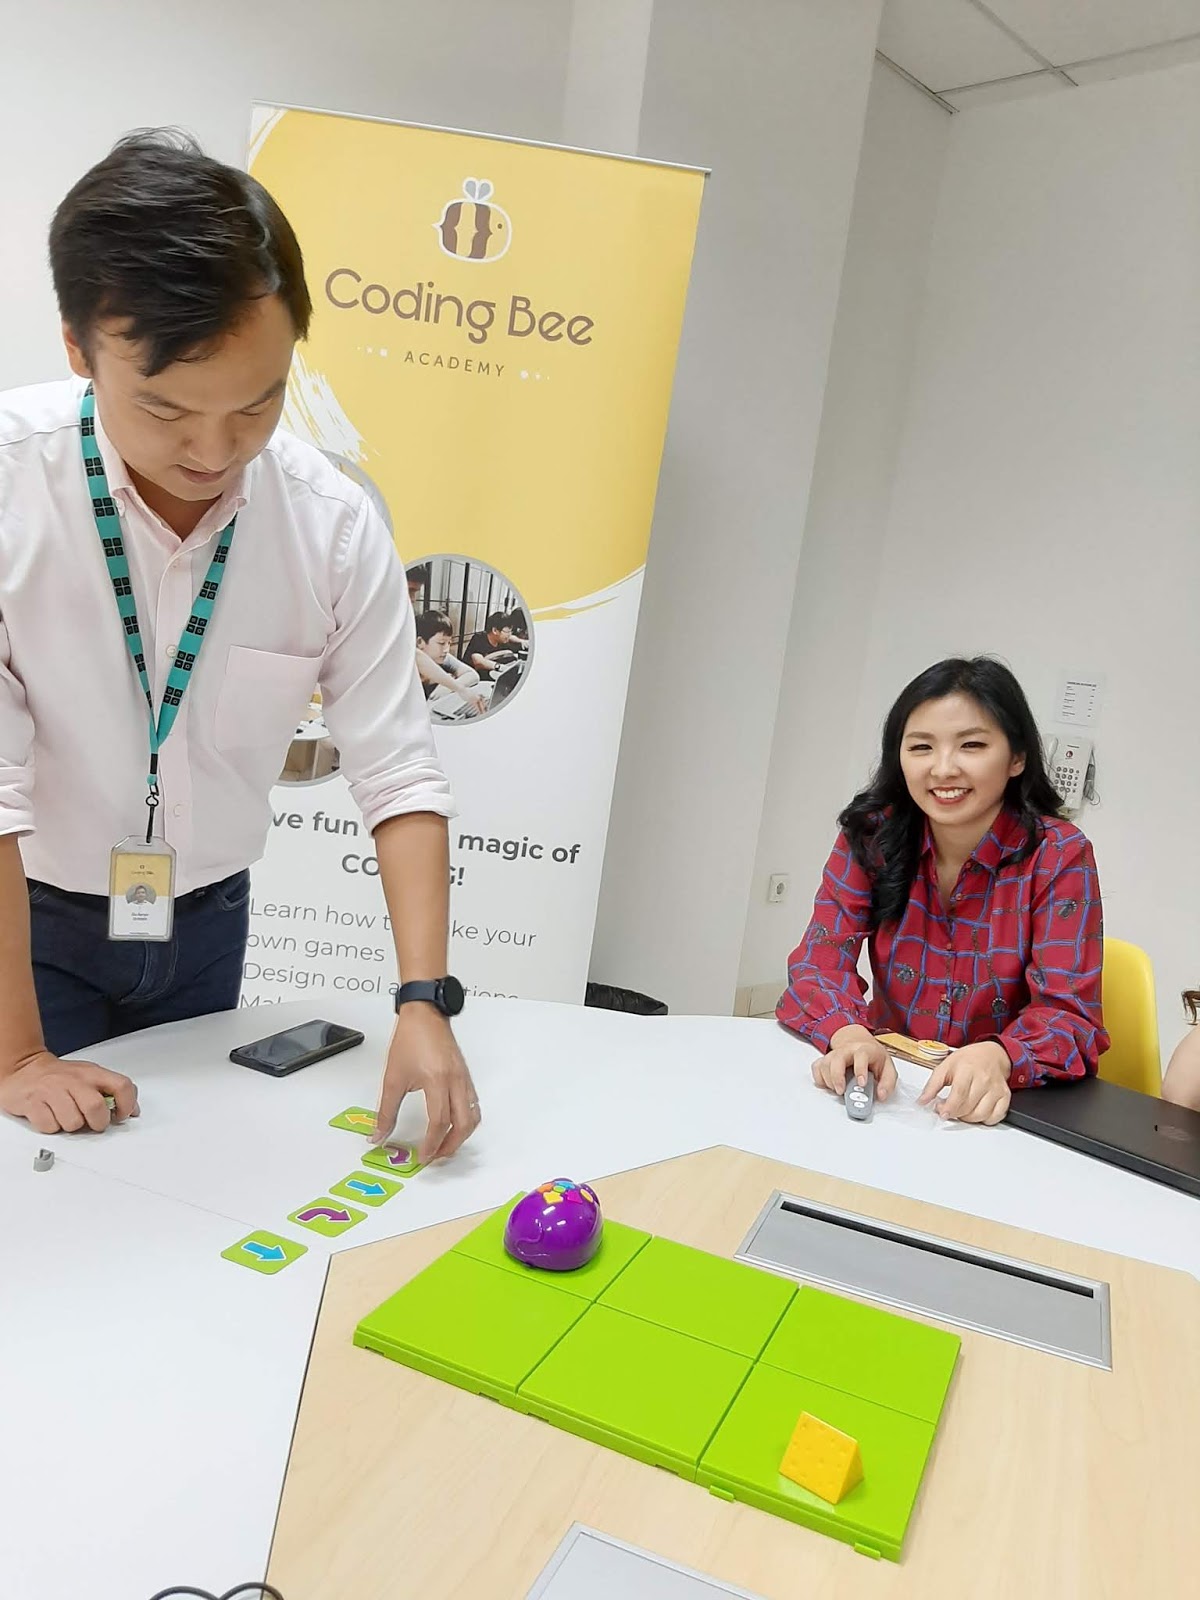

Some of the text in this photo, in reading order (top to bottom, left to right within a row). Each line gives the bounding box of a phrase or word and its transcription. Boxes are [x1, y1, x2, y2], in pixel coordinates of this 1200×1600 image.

[325, 268, 595, 346] Coding Bee
[404, 351, 506, 378] ACADEMY
[273, 811, 581, 864] ve fun magic of
[250, 898, 317, 921] Learn
[325, 905, 377, 929] how
[451, 920, 479, 940] ke
[483, 928, 537, 947] your
[246, 934, 385, 962] own games
[243, 962, 325, 989] Design
[333, 976, 381, 994] cool
